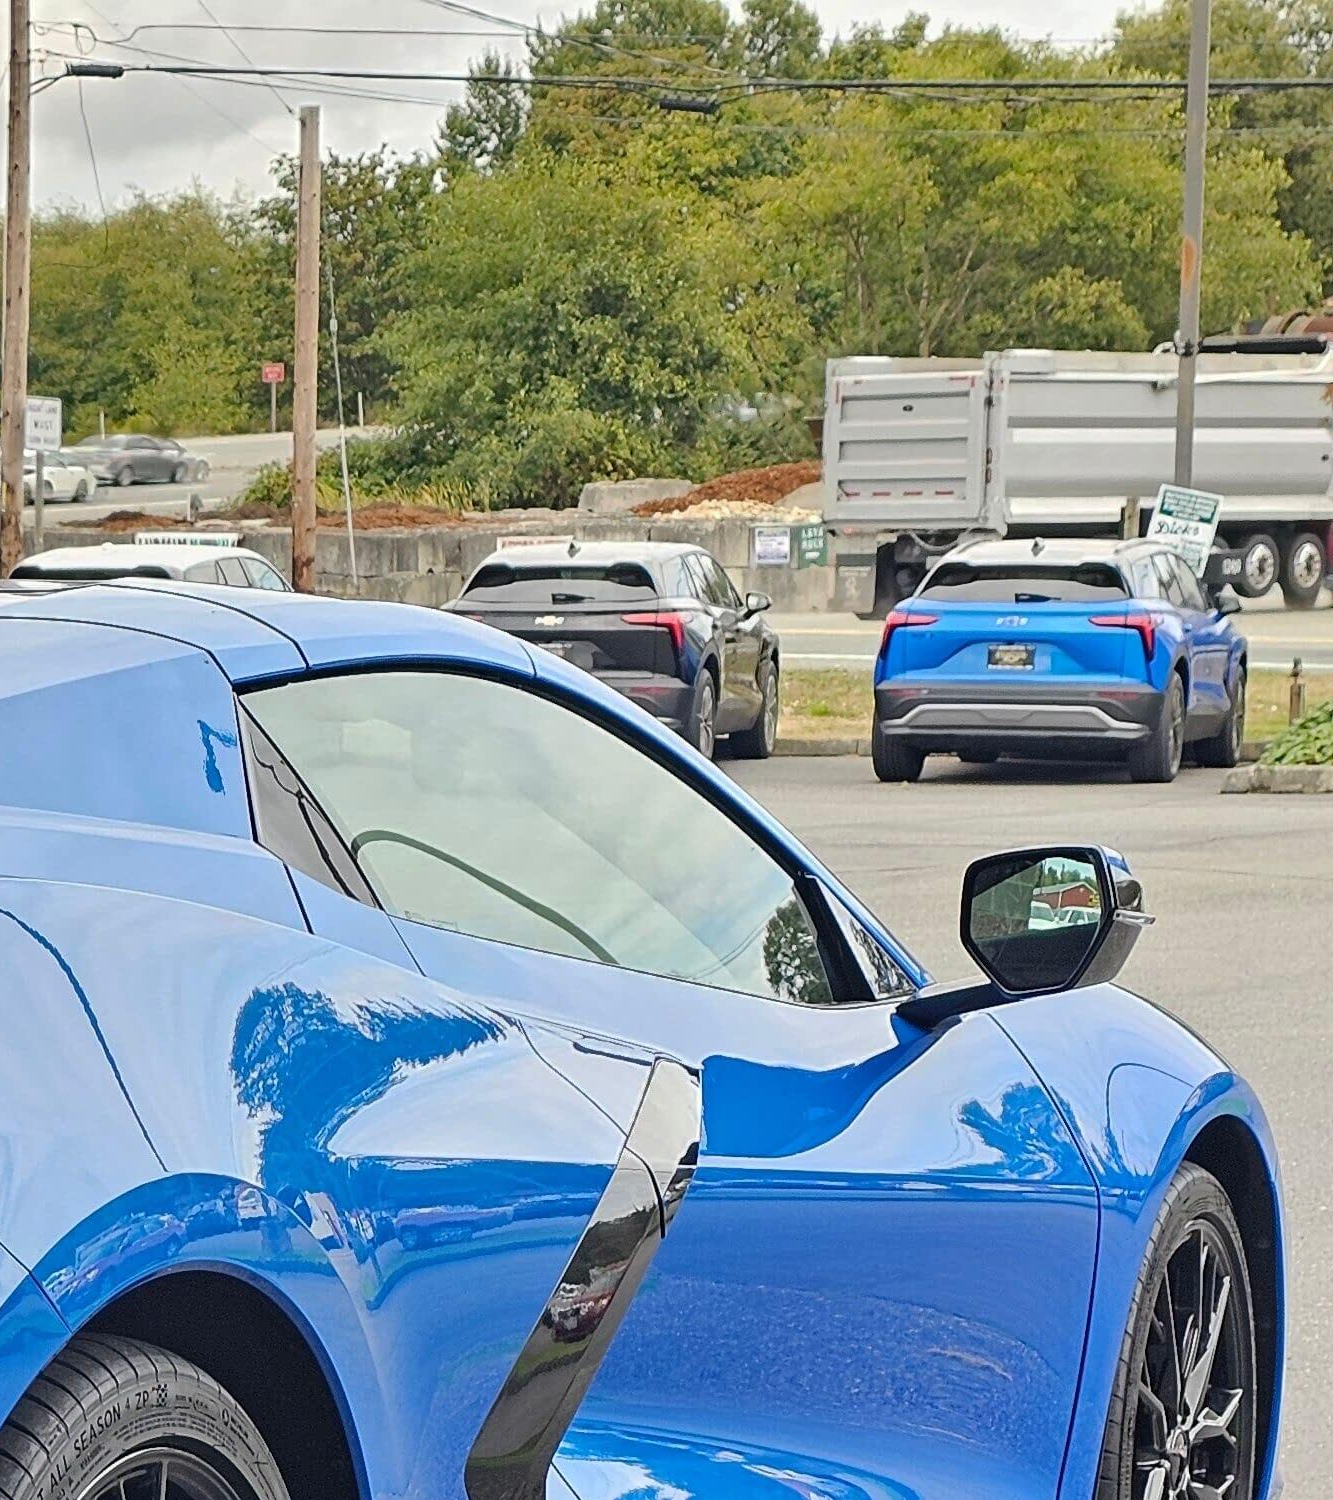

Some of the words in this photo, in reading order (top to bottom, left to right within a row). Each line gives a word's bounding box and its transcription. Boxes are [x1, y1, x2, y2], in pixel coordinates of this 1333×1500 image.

[49, 1456, 72, 1494] ALL
[73, 1406, 122, 1458] SEASON
[135, 1389, 150, 1411] ZP
